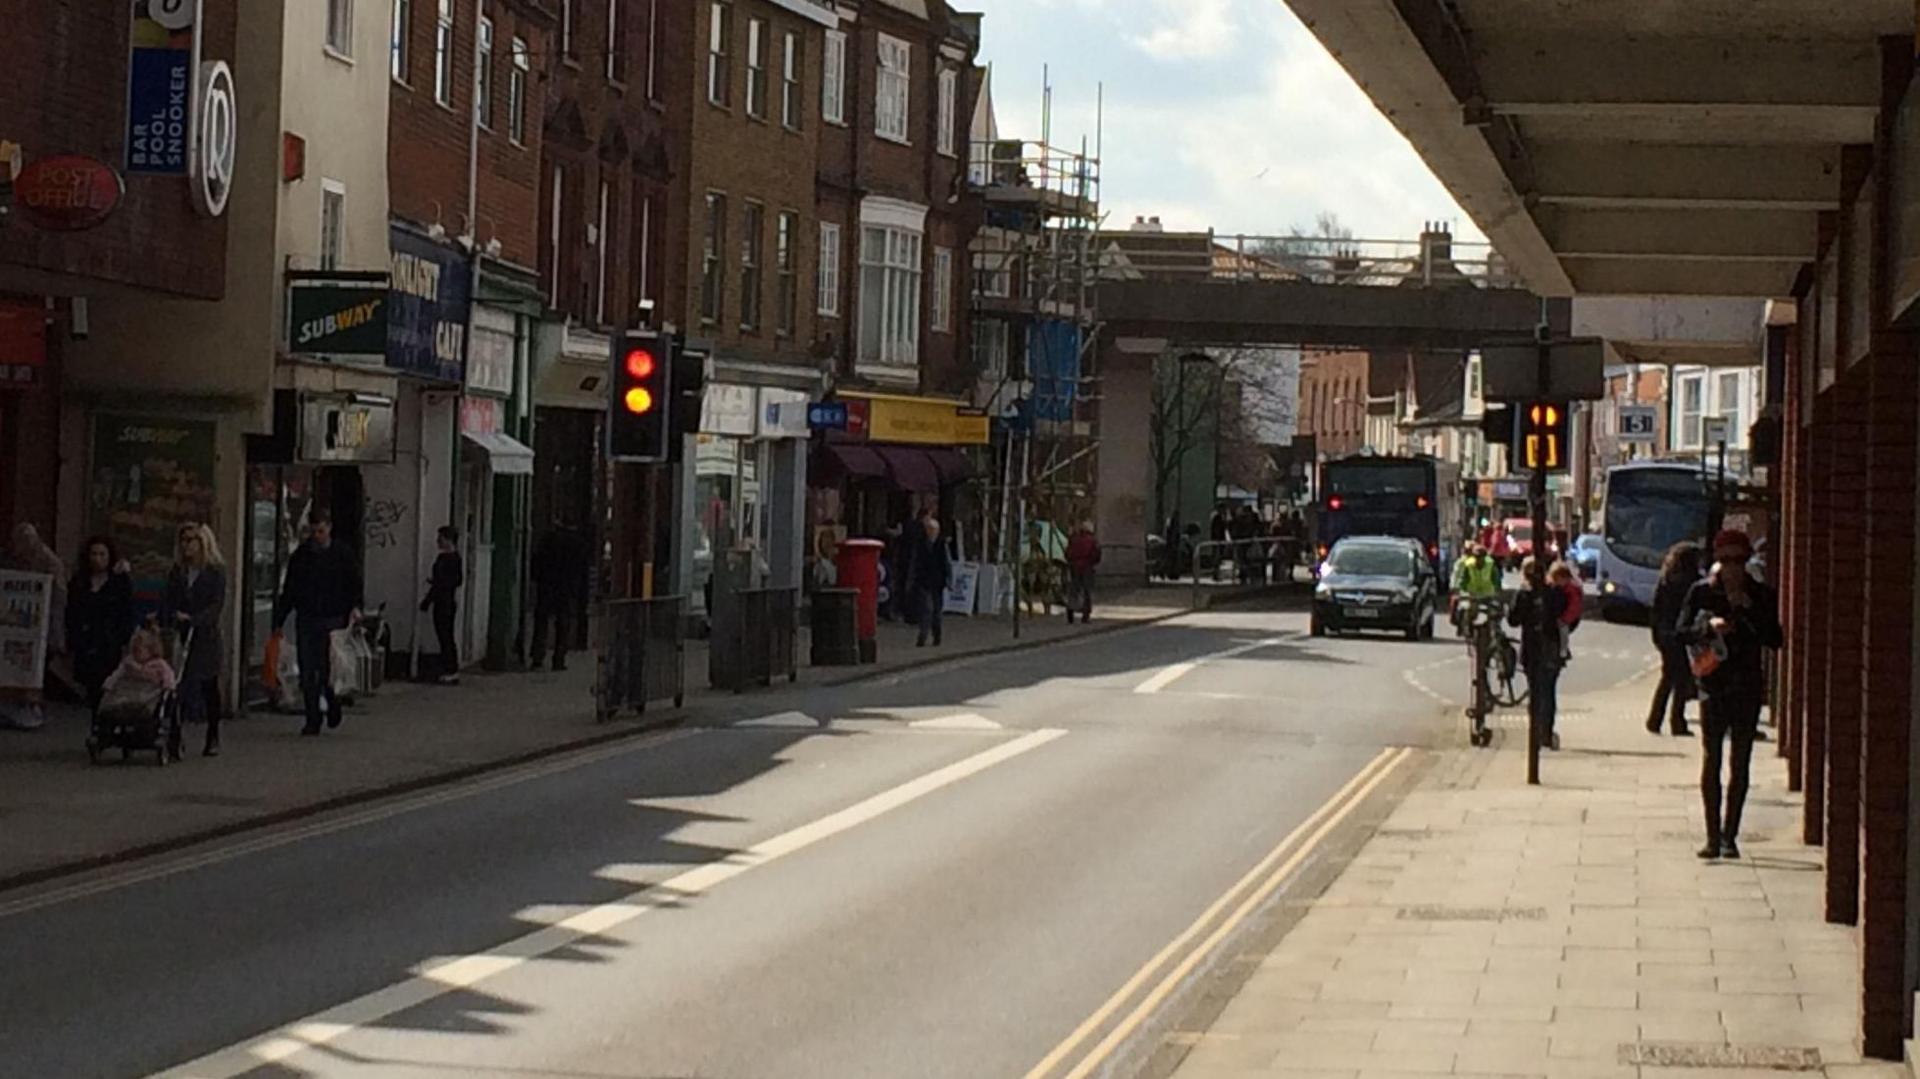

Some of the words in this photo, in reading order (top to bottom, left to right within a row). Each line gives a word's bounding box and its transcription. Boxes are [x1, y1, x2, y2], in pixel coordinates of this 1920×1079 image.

[167, 65, 187, 165] SNOOKER
[132, 123, 149, 164] BAR
[150, 108, 167, 166] POOL
[39, 166, 96, 186] POST
[26, 187, 102, 209] OFFICE
[297, 299, 381, 344] SUBWAY
